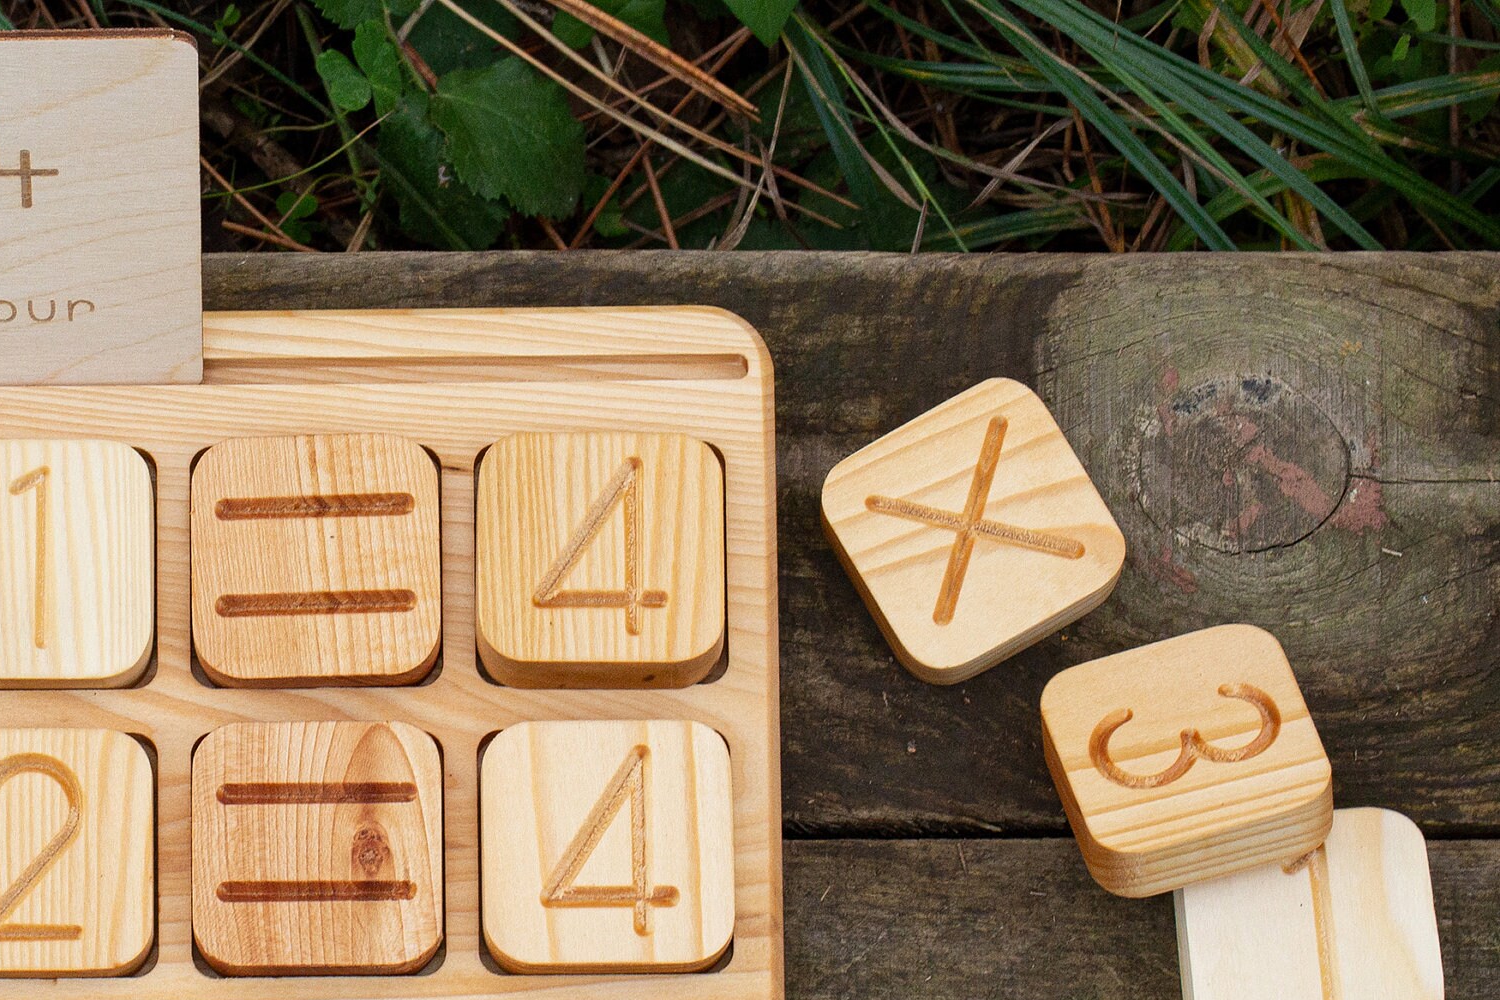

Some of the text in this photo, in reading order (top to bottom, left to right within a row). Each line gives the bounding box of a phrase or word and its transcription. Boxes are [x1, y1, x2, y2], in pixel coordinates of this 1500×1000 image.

[8, 466, 51, 650] 1
[534, 456, 668, 635] 4
[1089, 683, 1282, 790] 3
[540, 744, 681, 936] 4
